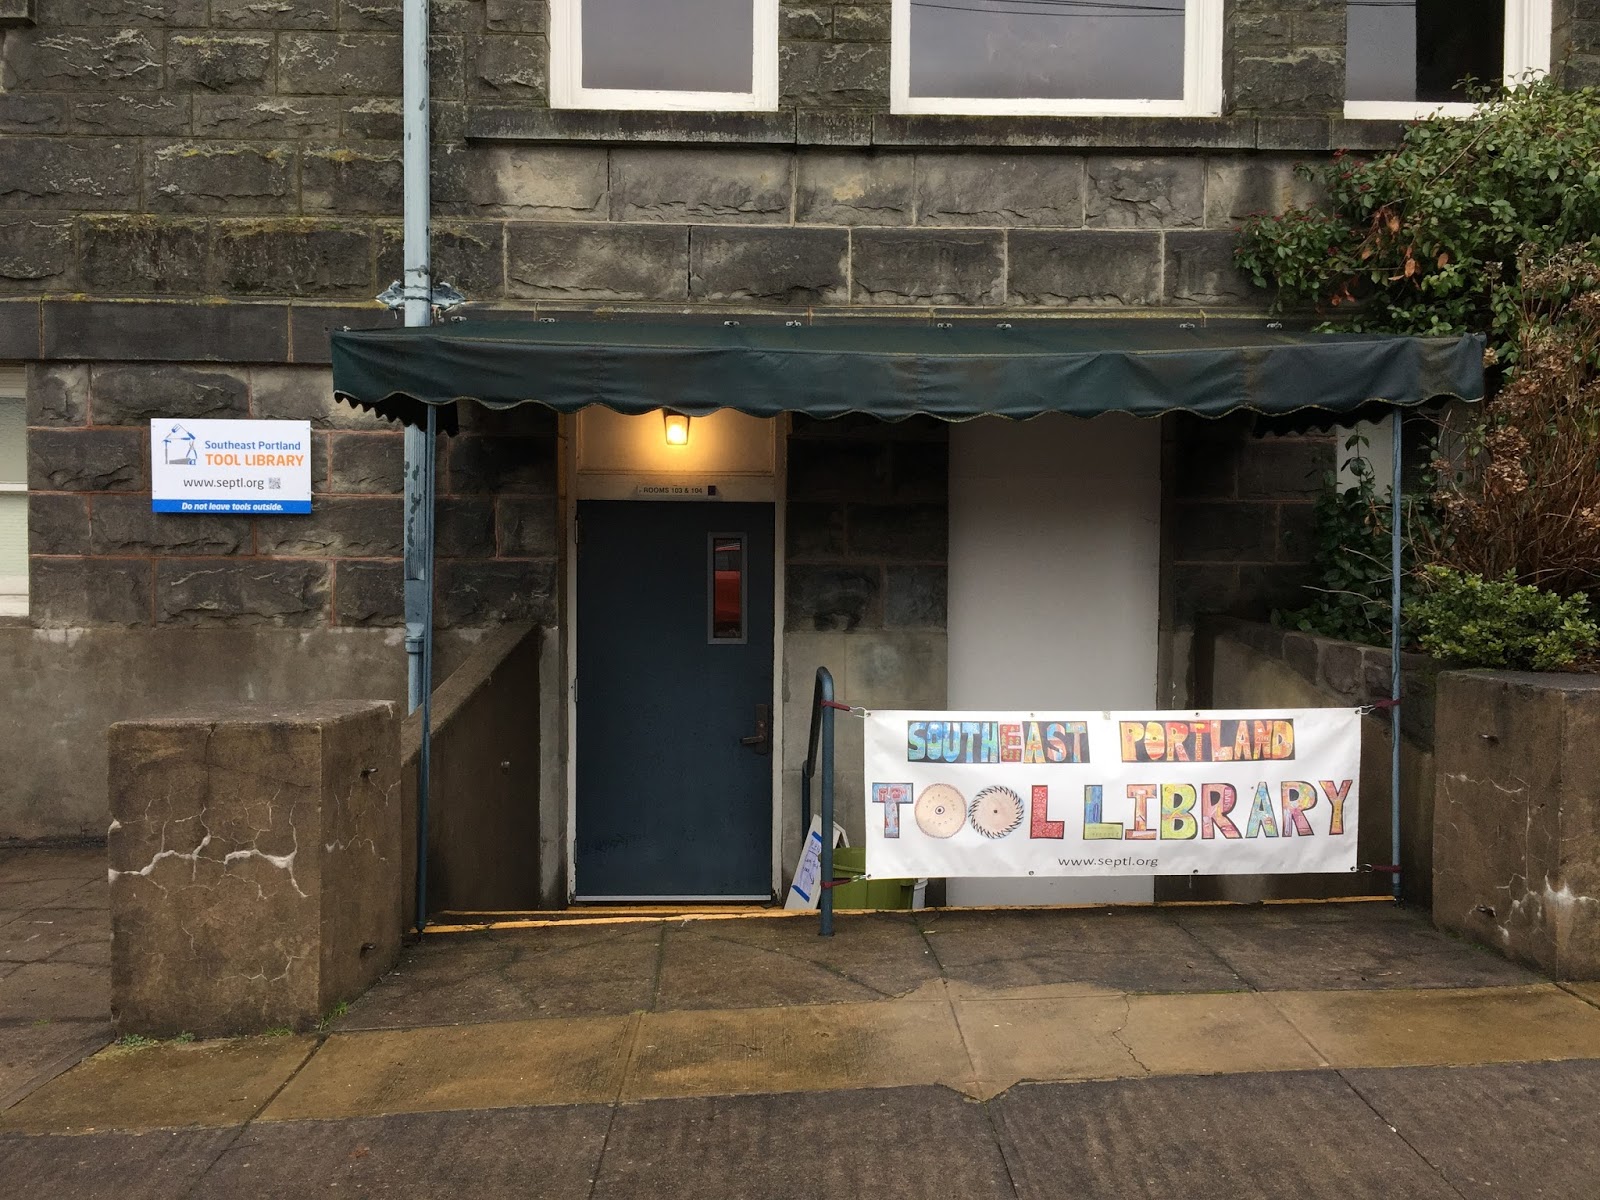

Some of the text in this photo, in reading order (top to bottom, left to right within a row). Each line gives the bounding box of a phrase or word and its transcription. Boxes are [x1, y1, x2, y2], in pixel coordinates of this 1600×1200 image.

[205, 440, 301, 451] Southeast Portland
[205, 453, 304, 467] TOOL LIBRARY
[183, 478, 265, 490] www.septl.org
[181, 502, 284, 511] Do not leave tools outside.
[908, 720, 1090, 763] SOUTHEAST
[1119, 719, 1295, 763] PORTLAND
[872, 780, 1353, 841] TOOL LIBRARY
[1057, 856, 1159, 868] www.septl.org
